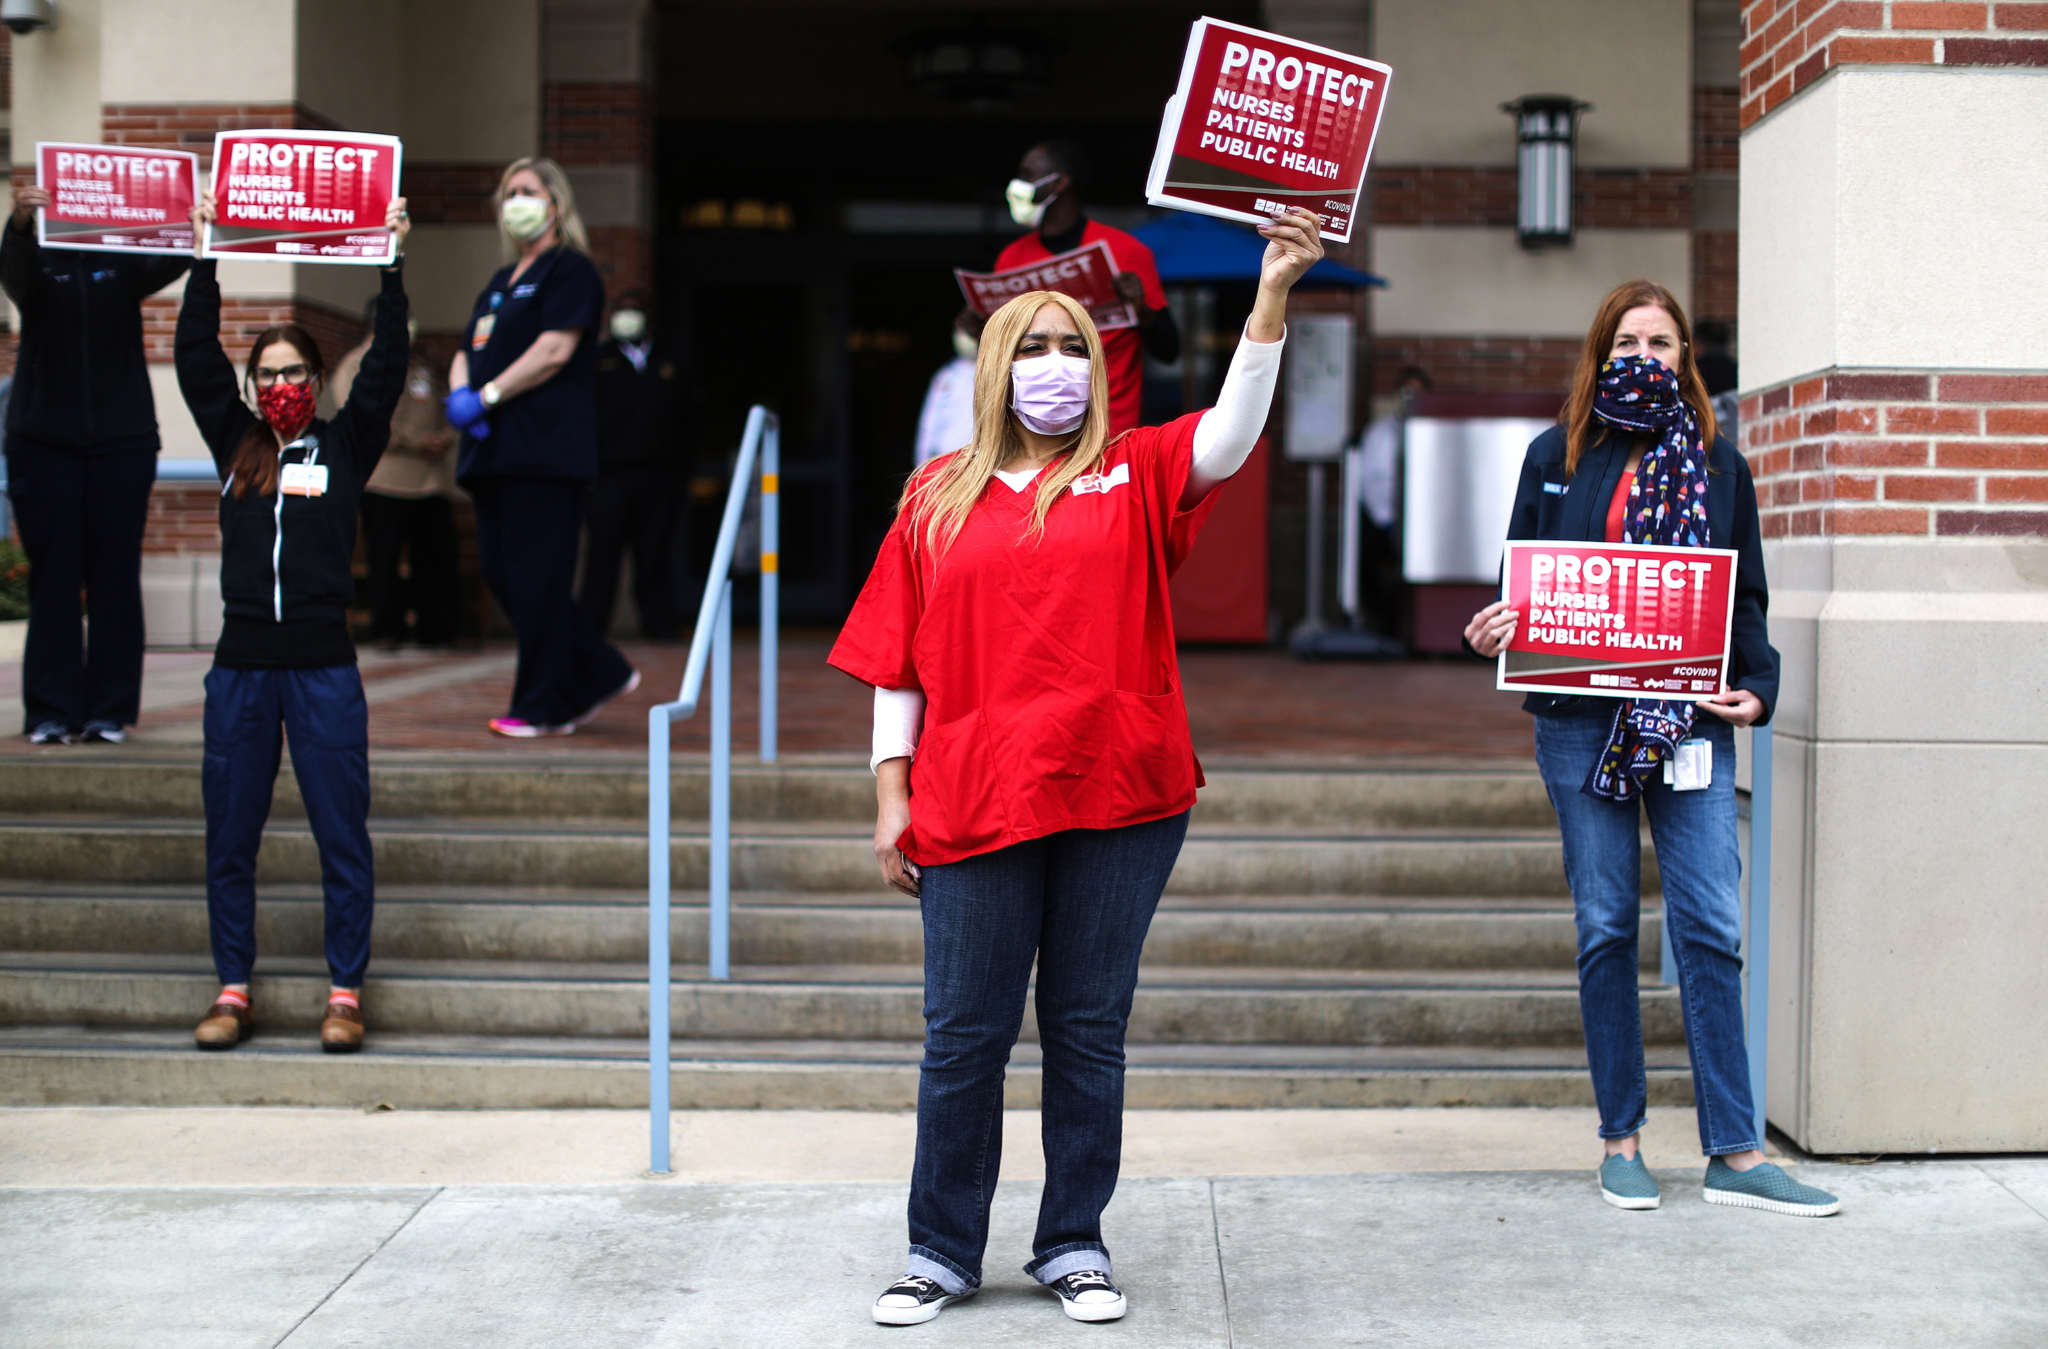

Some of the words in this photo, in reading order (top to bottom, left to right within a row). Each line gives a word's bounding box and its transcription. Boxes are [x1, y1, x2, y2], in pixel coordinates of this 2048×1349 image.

[1220, 41, 1374, 110] PROTECT
[1211, 87, 1295, 123] NURSES
[1205, 110, 1305, 148] PATIENTS
[56, 151, 182, 180] PROTECT
[231, 143, 379, 172] PROTECT
[1200, 132, 1278, 165] PUBLIC
[1281, 151, 1339, 180] HEALTH
[56, 178, 114, 193] NURSES
[228, 174, 293, 192] NURSES
[56, 190, 126, 206] PATIENTS
[228, 189, 306, 206] PATIENTS
[1324, 199, 1351, 213] #COVID19
[56, 203, 108, 218] PUBLIC
[111, 206, 166, 222] HEALTH
[227, 204, 285, 221] PUBLIC
[288, 207, 355, 224] HEALTH
[972, 255, 1094, 294] PROTECT
[1531, 553, 1712, 591] PROTECT
[1530, 590, 1610, 611] NURSES
[1529, 609, 1626, 630] PATIENTS
[1528, 627, 1601, 646] PUBLIC
[1605, 632, 1683, 651] HEALTH
[1672, 666, 1718, 677] #COVID19
